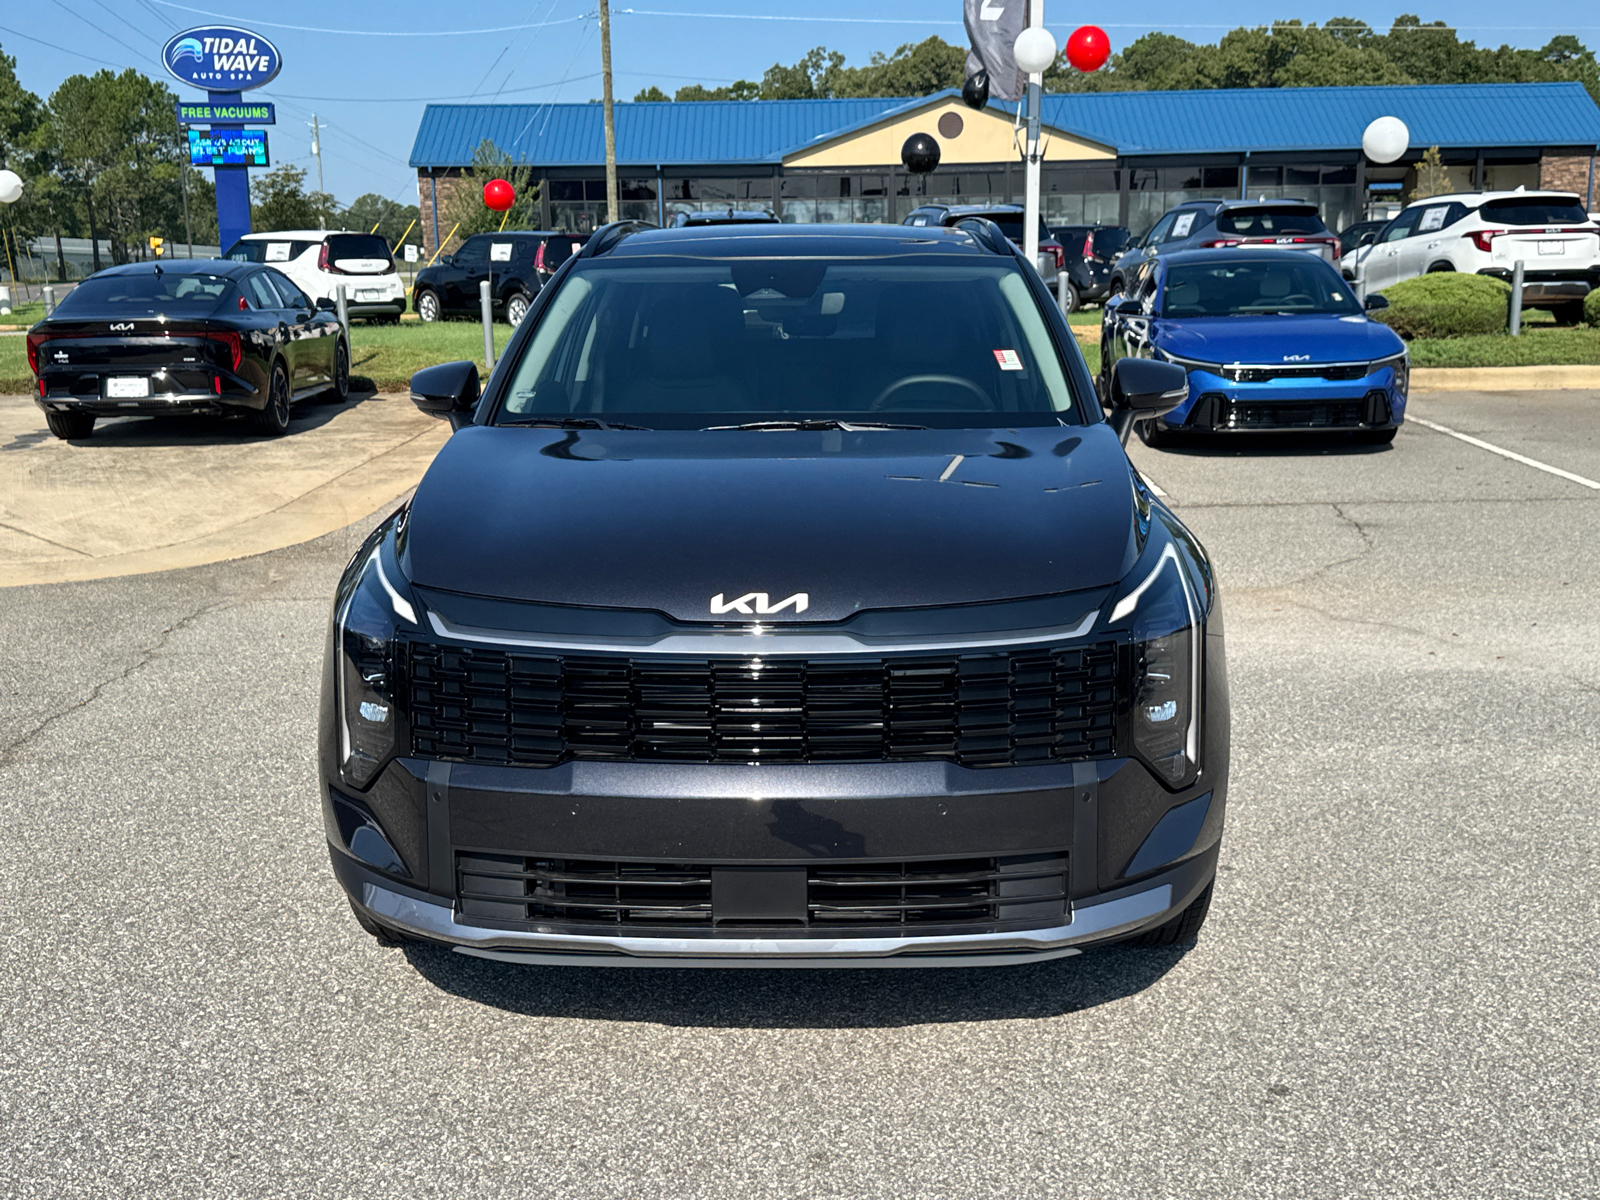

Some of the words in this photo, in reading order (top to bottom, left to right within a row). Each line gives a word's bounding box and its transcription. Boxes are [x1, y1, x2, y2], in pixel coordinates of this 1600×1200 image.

[203, 37, 258, 55] TIDAL
[213, 54, 270, 72] WAVE
[192, 72, 222, 80] AUTO
[230, 72, 252, 80] SPA
[181, 106, 212, 118] FREE
[213, 106, 269, 118] VACUUMS
[109, 323, 135, 331] KIA
[710, 592, 809, 614] KIA
